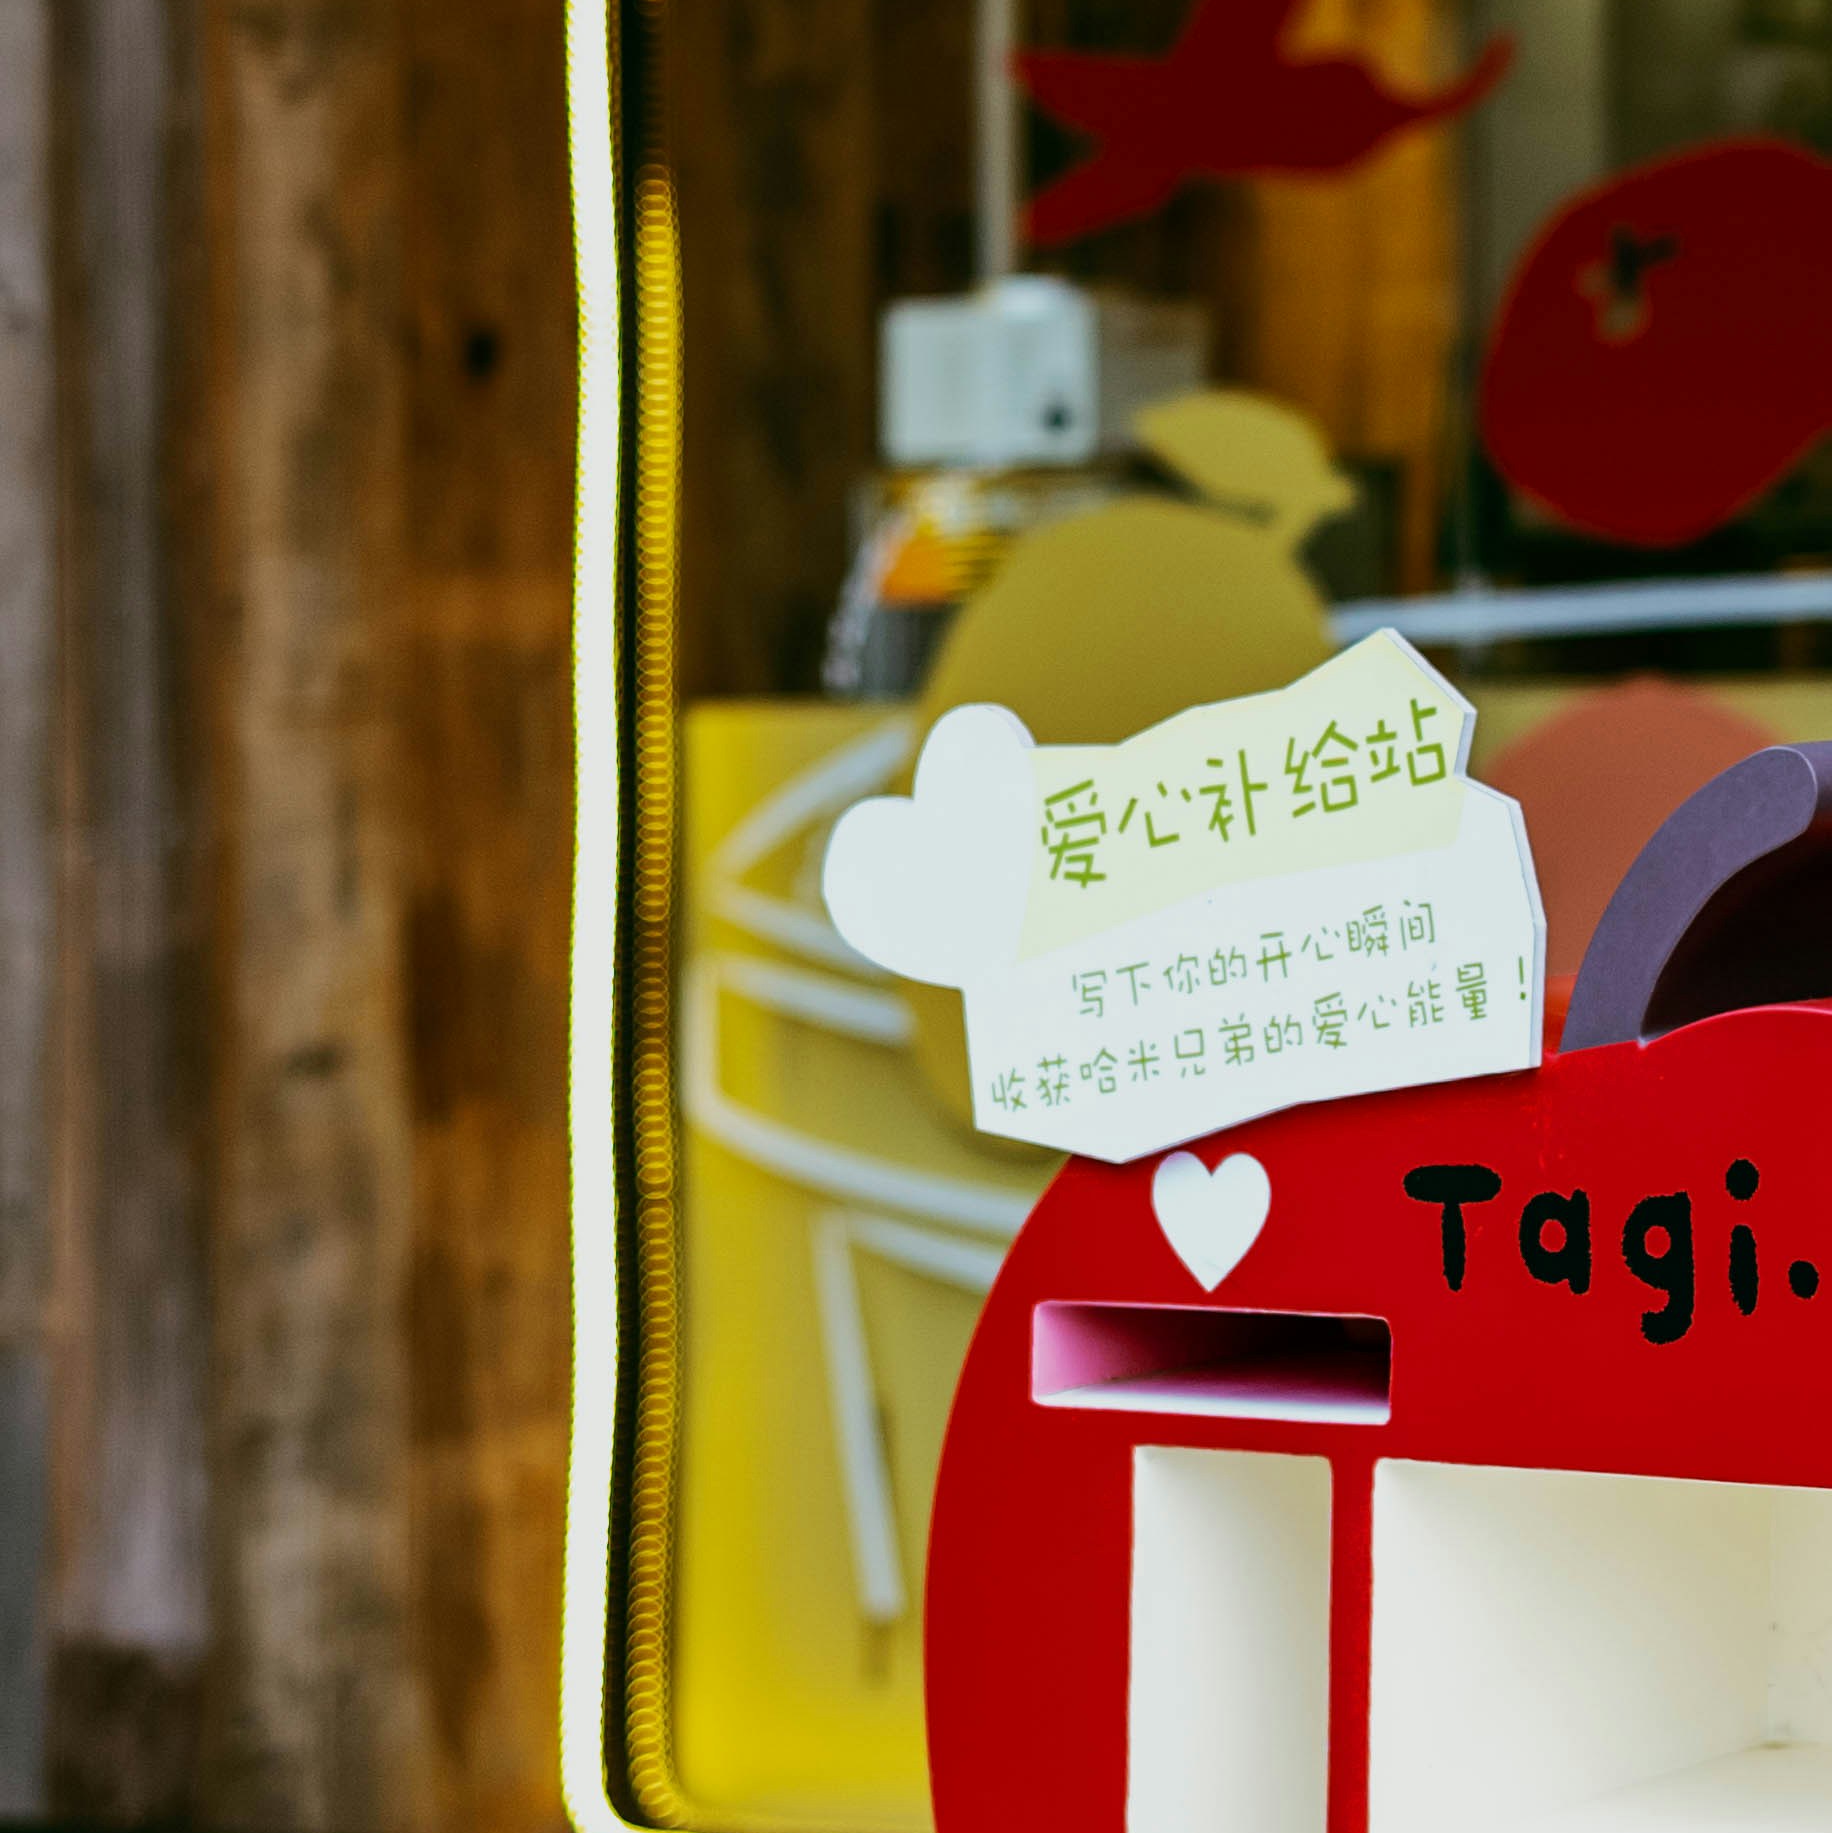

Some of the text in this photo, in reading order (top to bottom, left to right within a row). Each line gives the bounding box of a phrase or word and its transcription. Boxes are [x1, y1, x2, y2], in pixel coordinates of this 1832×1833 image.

[1041, 697, 1447, 888] 爱心补给站
[1072, 900, 1437, 1019] 写下你的开心瞬间
[1402, 1158, 1820, 1345] Tagi.
